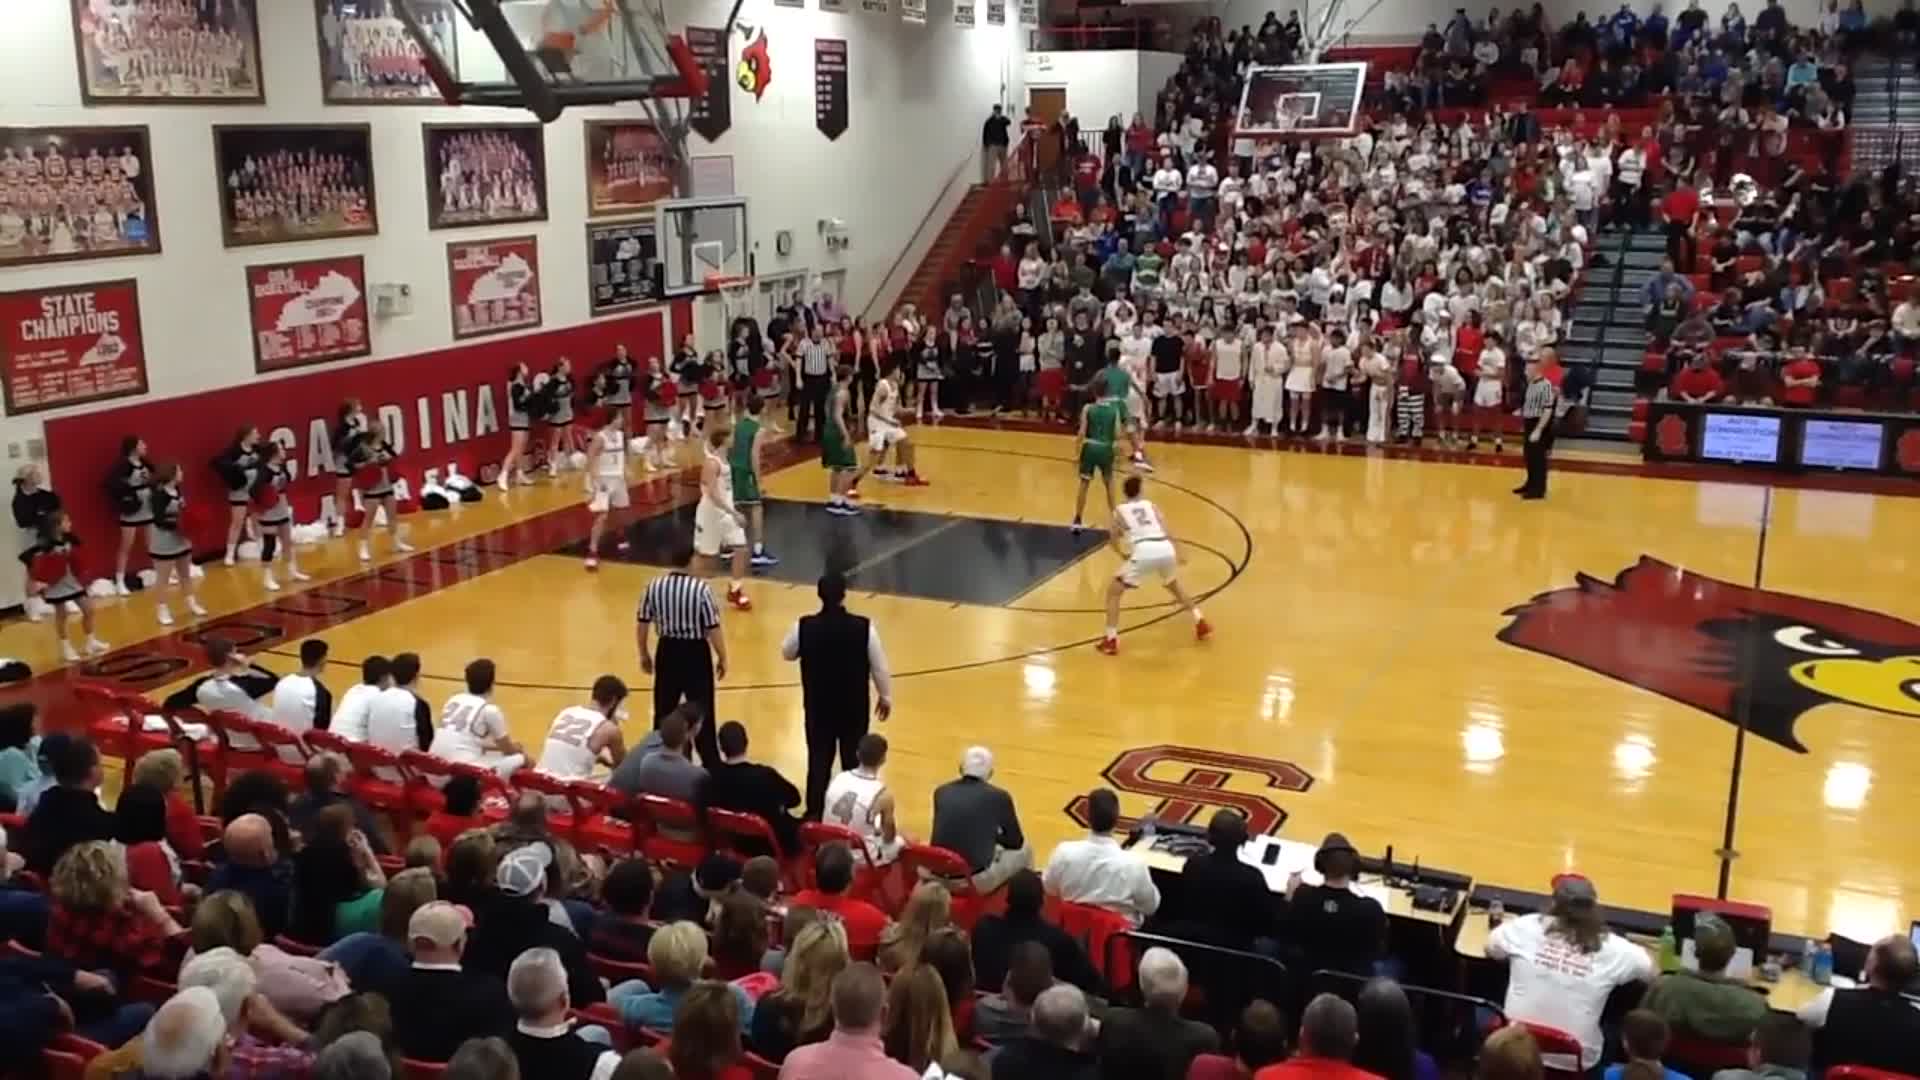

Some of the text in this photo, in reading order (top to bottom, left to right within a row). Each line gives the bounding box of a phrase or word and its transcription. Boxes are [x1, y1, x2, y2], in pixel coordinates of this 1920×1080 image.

[41, 292, 96, 318] STATE
[20, 311, 120, 341] CHAMPIONS
[1131, 507, 1152, 527] 2
[441, 702, 474, 732] 24
[549, 713, 593, 747] 22
[832, 790, 858, 823] 4
